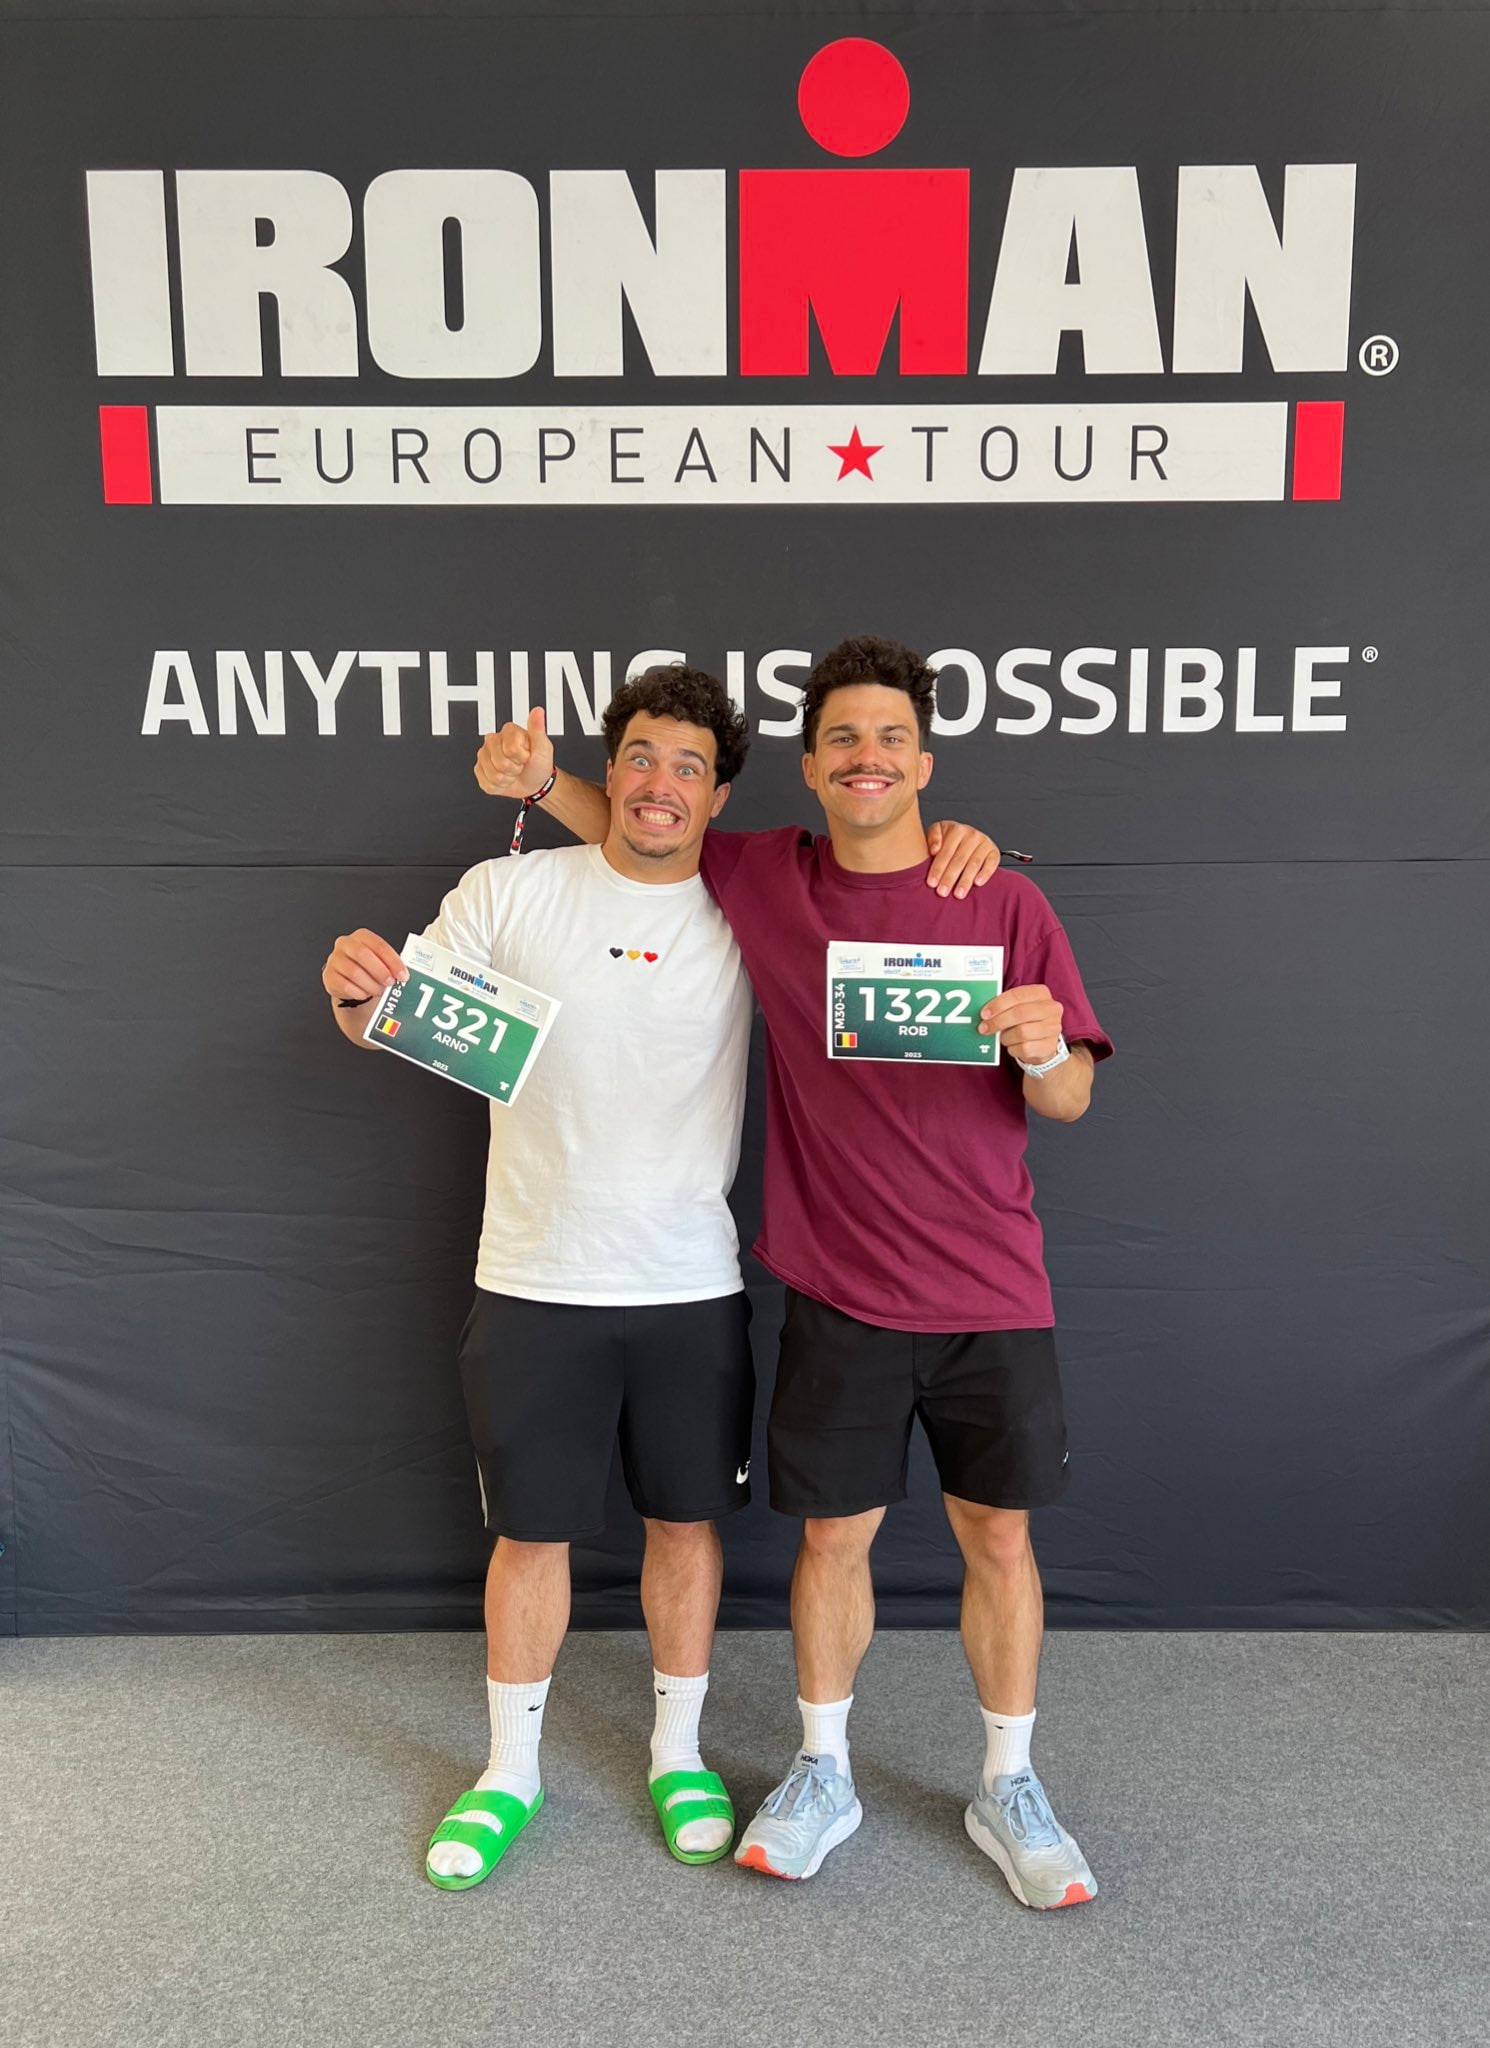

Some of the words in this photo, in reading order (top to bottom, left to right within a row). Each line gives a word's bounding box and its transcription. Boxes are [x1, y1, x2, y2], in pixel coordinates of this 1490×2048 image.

[86, 37, 1357, 379] IRONMAN
[245, 427, 791, 484] EUROPEAN
[911, 425, 1170, 482] TOUR
[726, 649, 812, 737] IS
[931, 645, 1350, 737] OSSIBLE
[883, 952, 943, 968] IRONMAN
[383, 980, 408, 1015] M18-
[450, 965, 499, 995] IRONMAN
[414, 982, 509, 1054] 1321
[834, 982, 846, 1030] M30-34
[858, 986, 972, 1024] 1322
[431, 1030, 469, 1054] ARNO
[898, 1025, 928, 1036] ROB
[801, 1754, 819, 1766] HOKA
[1010, 1775, 1031, 1787] HOKA
